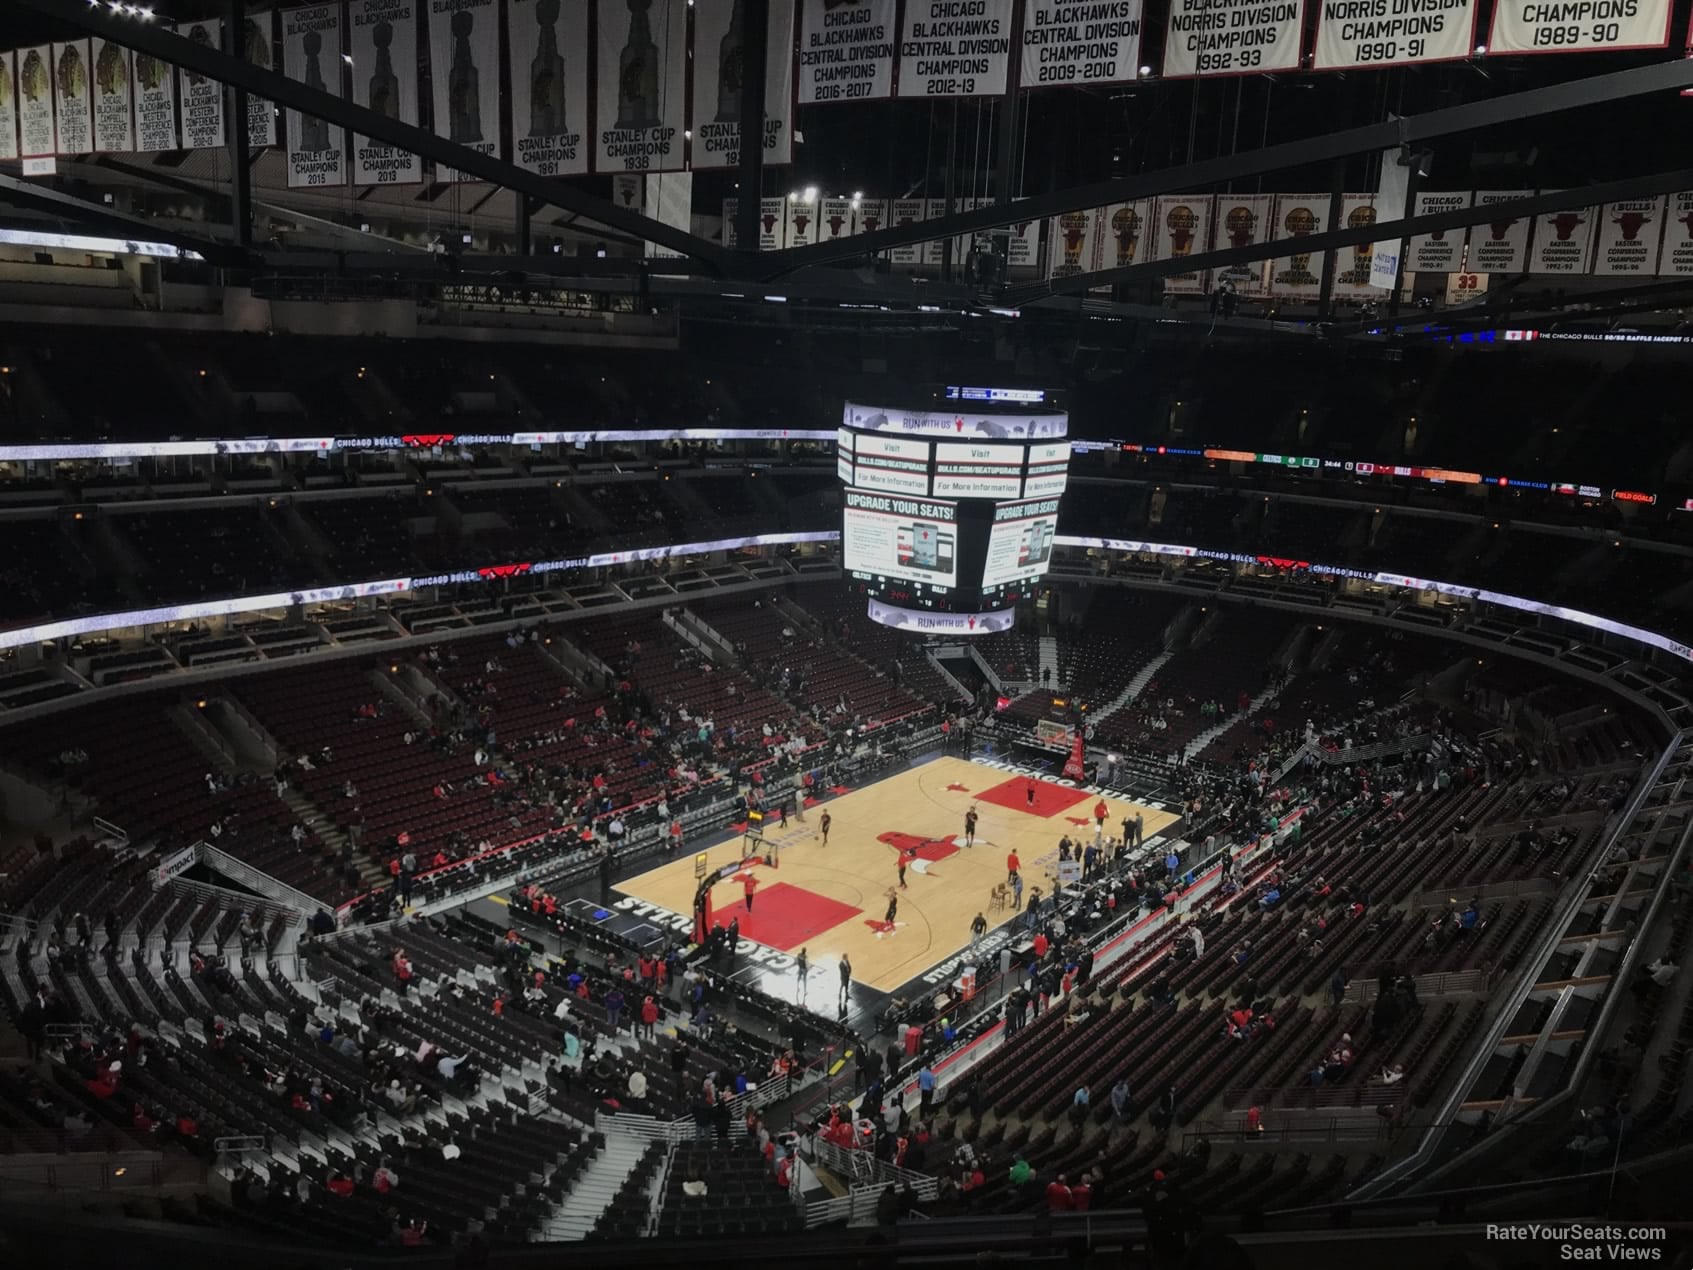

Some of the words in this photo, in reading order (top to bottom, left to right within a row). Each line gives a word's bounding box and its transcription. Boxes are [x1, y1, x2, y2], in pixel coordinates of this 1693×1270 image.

[295, 8, 329, 22] CHICAGO
[355, 8, 411, 26] BLACKHAWKS
[930, 2, 986, 18] CHICAGO
[1035, 2, 1129, 26] BLACKHAWKS
[1172, 12, 1226, 32] NORRIS
[1231, 3, 1297, 27] DIVISION
[1325, 0, 1387, 20] NORRIS
[1522, 0, 1638, 23] CHAMPIONS
[823, 9, 871, 27] CHICAGO
[288, 17, 337, 35] BLACKHAWKS
[913, 19, 1000, 38] BLACKHAWKS
[1024, 26, 1081, 45] CENTRAL
[1085, 20, 1140, 41] DIVISION
[1341, 15, 1444, 40] CHAMPIONS
[810, 26, 884, 47] BLACKHAWKS
[1187, 27, 1277, 51] CHAMPIONS
[1533, 24, 1619, 46] 1989-90
[801, 50, 847, 66] CENTRAL
[849, 43, 893, 61] DIVISION
[902, 42, 955, 56] CENTRAL
[958, 38, 1009, 55] DIVISION
[1040, 42, 1118, 63] CHAMPIONS
[1355, 39, 1424, 61] 1990-91
[917, 59, 989, 76] CHAMPIONS
[1196, 50, 1261, 70] 1992-93
[814, 64, 876, 82] CHAMPIONS
[1039, 61, 1116, 81] 2009-2010
[190, 86, 211, 97] CHICAGO
[815, 82, 873, 100] 2016-2017
[927, 79, 975, 94] 2012-13
[139, 101, 171, 112] BLACKHAWKS
[184, 95, 218, 107] BLACKHAWKS
[143, 111, 166, 121] WESTERN
[190, 106, 215, 116] WESTERN
[140, 120, 171, 131] CONFERENCE
[185, 115, 219, 127] CONFERENCE
[143, 130, 169, 140] CHAMPIONS
[188, 126, 217, 137] CHAMPIONS
[602, 130, 647, 145] STANLEY
[651, 127, 676, 141] CUP
[700, 123, 742, 138] STANLE
[765, 120, 783, 134] UP
[518, 135, 557, 151] STANLEY
[560, 134, 580, 147] CUP
[607, 142, 670, 157] CHAMPIONS
[705, 135, 777, 152] CHAMNS
[291, 151, 323, 163] STANLEY
[325, 149, 341, 161] CUP
[359, 147, 391, 160] STANLEY
[522, 148, 576, 164] CHAMPIONS
[295, 162, 338, 174] CHAMPIONS
[363, 158, 412, 171] CHAMPIONS
[538, 162, 559, 175] 1961
[623, 156, 649, 169] 1938
[308, 175, 326, 185] 2015
[378, 171, 397, 182] 2013
[1422, 197, 1463, 205] CHICAGO
[1458, 275, 1478, 289] 33
[902, 418, 920, 430] RUN
[920, 419, 940, 429] WITH
[941, 420, 951, 429] US
[337, 438, 372, 448] CHICAGO
[374, 436, 398, 446] BULLS
[458, 434, 488, 445] CHICAGO
[884, 443, 900, 453] Visit
[971, 448, 990, 458] Visit
[858, 473, 868, 481] For
[869, 475, 885, 483] More
[886, 476, 925, 489] Information
[937, 482, 950, 490] For
[952, 483, 972, 491] More
[972, 483, 1017, 492] Information
[1615, 491, 1632, 499] FIELD
[1632, 493, 1653, 502] GOALS
[847, 493, 891, 511] UPGRADE
[892, 499, 918, 515] YOUR
[920, 505, 954, 520] SEATS!
[1199, 549, 1228, 560] CHICAGO
[1231, 553, 1253, 563] BULLS
[534, 561, 564, 572] CHICAGO
[1313, 565, 1346, 576] CHICAGO
[1349, 569, 1373, 579] BULLS
[413, 575, 448, 587] CHICAGO
[450, 571, 475, 583] BULLS
[918, 617, 935, 628] RUN
[936, 618, 954, 627] WITH
[954, 618, 964, 627] US
[970, 756, 1077, 787] CHICAGO
[1079, 784, 1167, 810] BULLS
